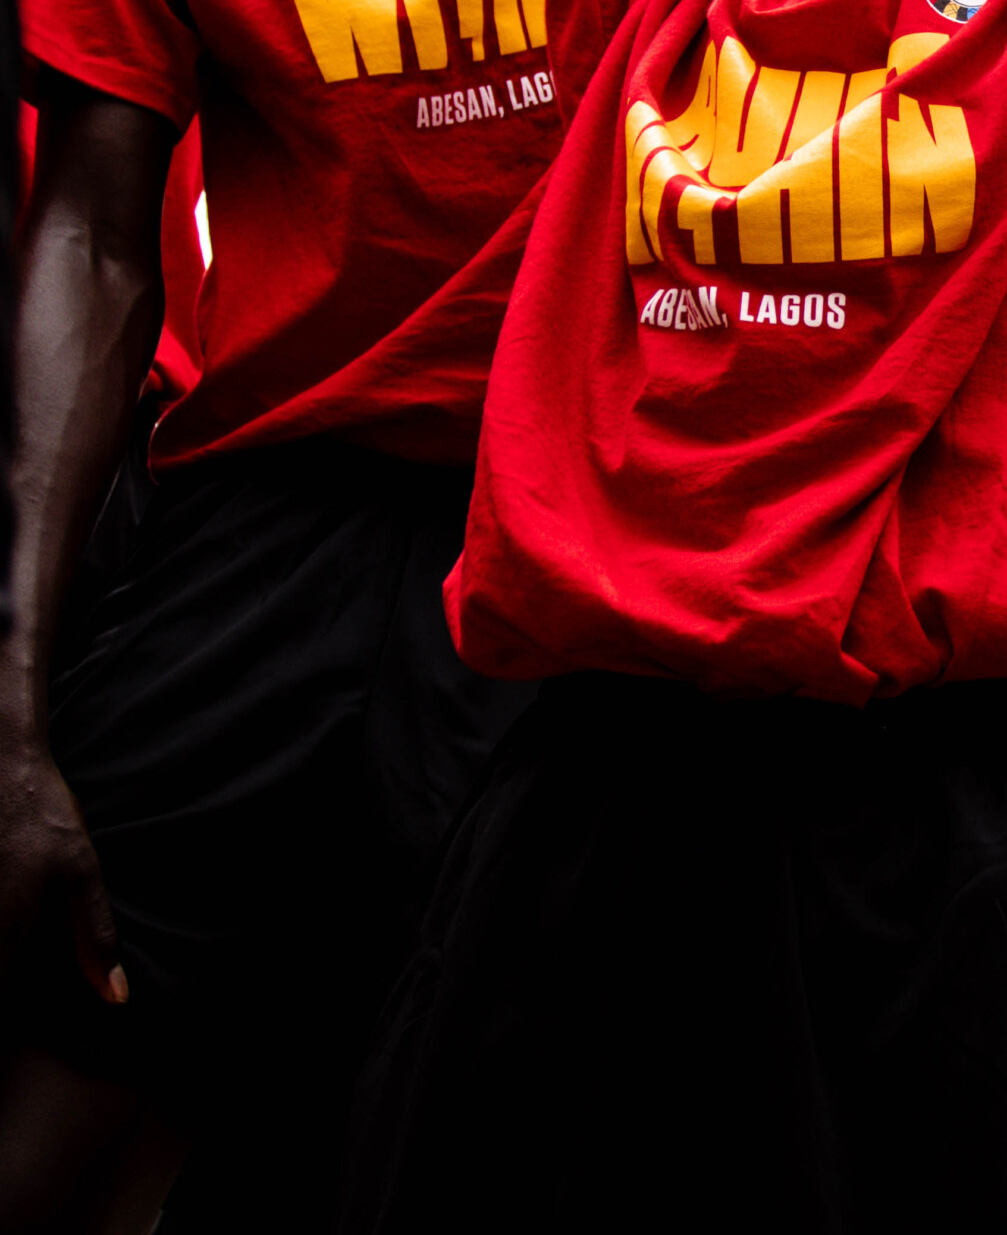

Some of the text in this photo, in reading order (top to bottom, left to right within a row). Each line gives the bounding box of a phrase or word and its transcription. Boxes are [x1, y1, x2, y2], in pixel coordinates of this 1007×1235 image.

[416, 70, 557, 129] ABESAN, LAG
[739, 292, 847, 330] LAGOS
